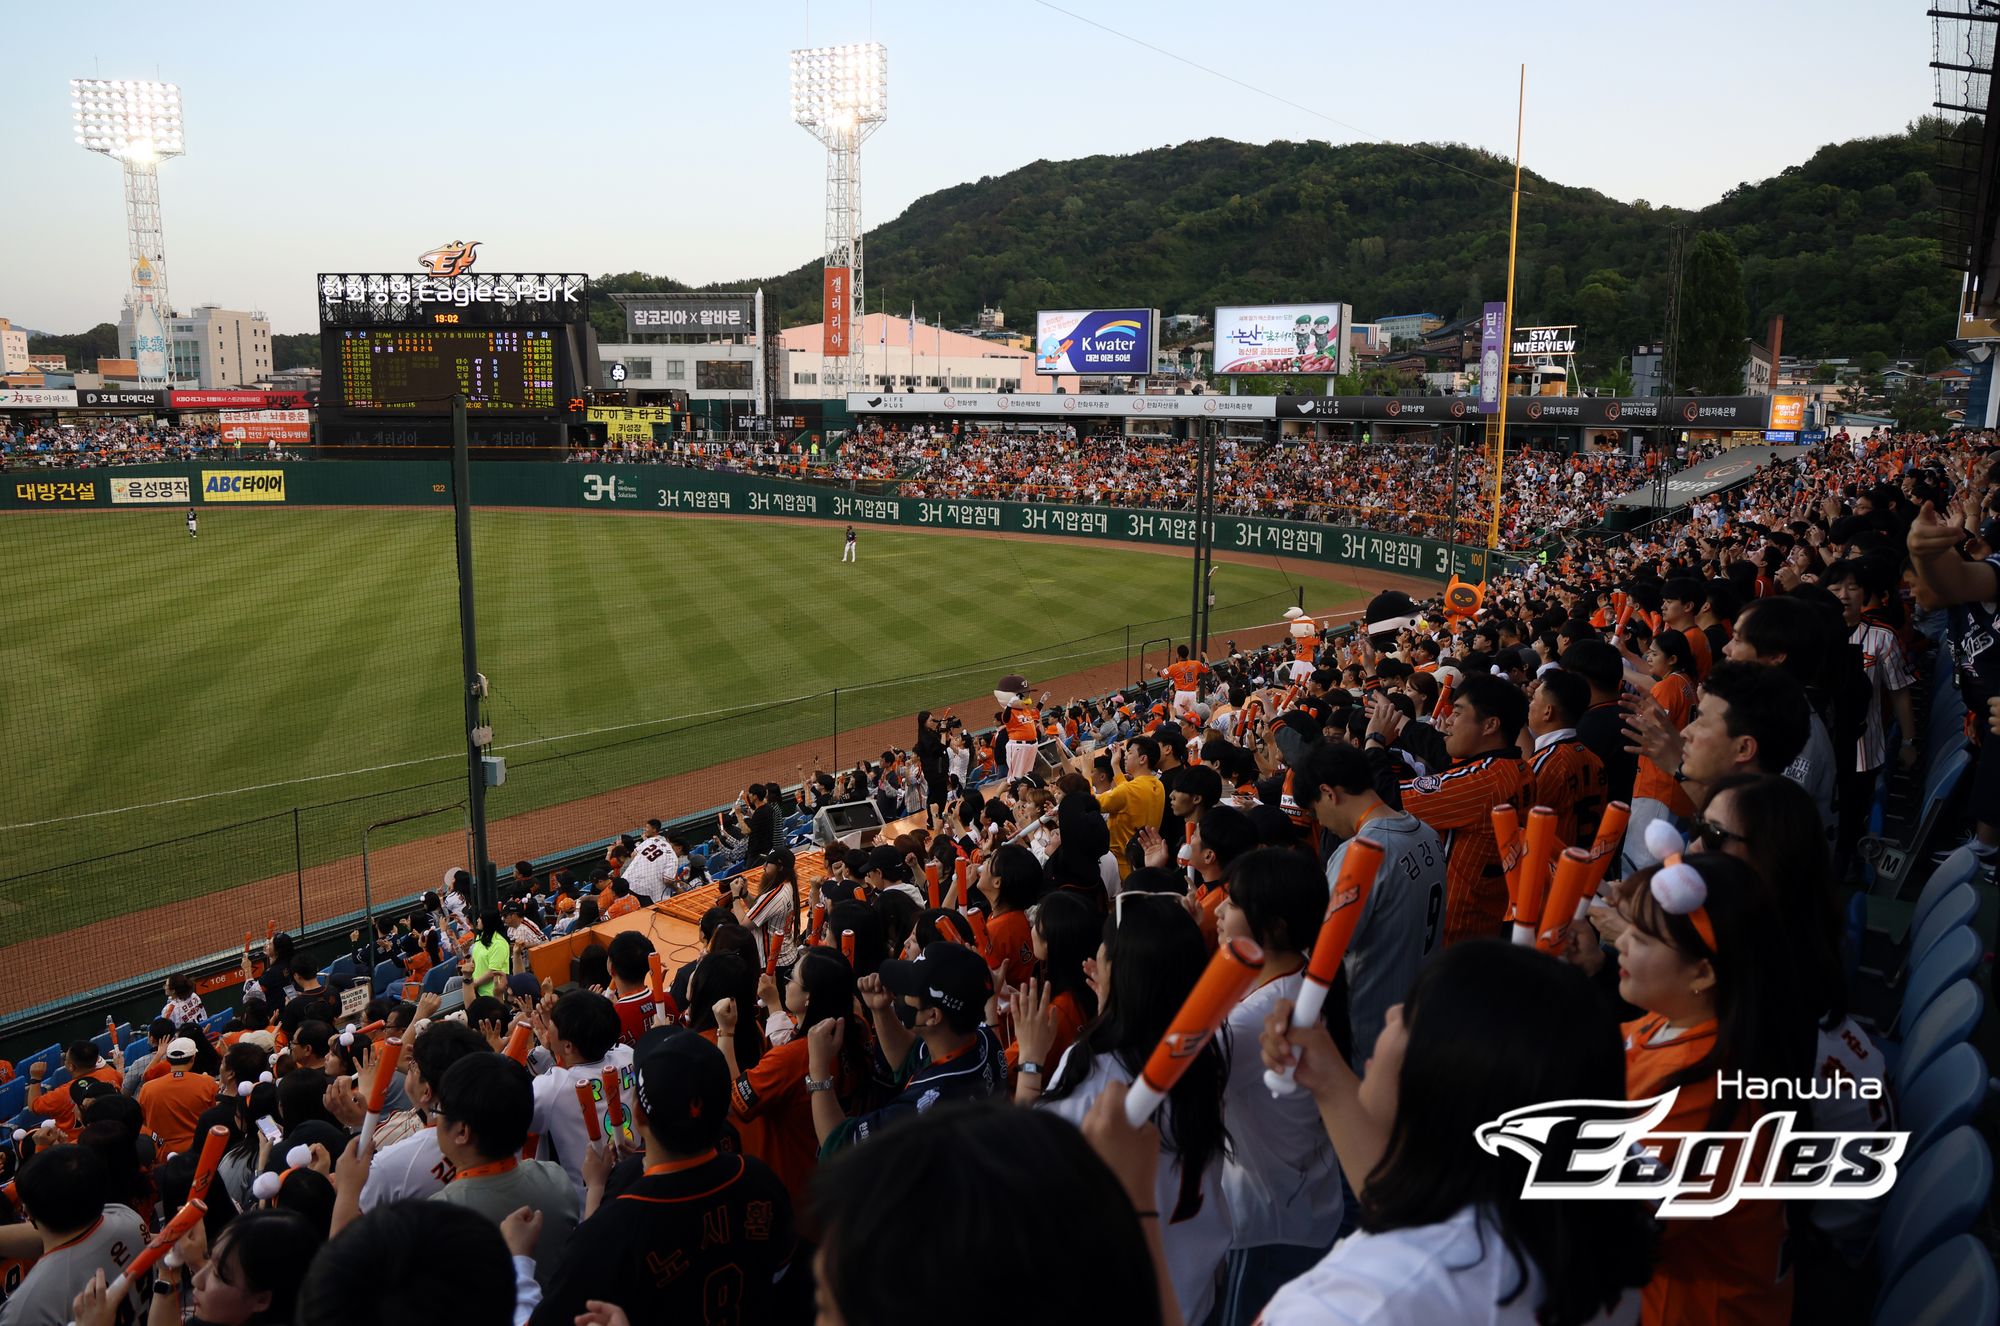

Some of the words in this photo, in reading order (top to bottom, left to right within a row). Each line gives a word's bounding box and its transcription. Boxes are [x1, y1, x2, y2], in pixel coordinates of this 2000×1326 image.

[322, 281, 411, 304] 한화생명
[418, 282, 510, 307] Eagles
[516, 282, 579, 302] Park
[434, 314, 458, 322] 19:02
[634, 310, 687, 325] 잡코리아
[700, 310, 740, 324] 알바몬
[831, 274, 842, 348] 갤러리아
[1484, 312, 1496, 338] 딥스
[1082, 338, 1092, 350] K
[1096, 338, 1135, 350] water
[1531, 330, 1558, 340] STAY
[1513, 341, 1575, 352] INTERVIEW
[1086, 354, 1099, 362] 대전
[1101, 354, 1113, 362] 이전
[1115, 354, 1130, 362] 50년
[101, 394, 118, 403] 호텔
[121, 394, 154, 403] 디에디션
[1542, 407, 1579, 415] 한화투자증권
[1621, 407, 1657, 416] 한화자산운용
[1699, 407, 1736, 417] 한화저축은행
[618, 424, 641, 432] 키성장
[373, 432, 417, 446] 갤러리아
[492, 432, 537, 446] 갤러리아
[16, 482, 96, 501] 대방건설
[128, 481, 188, 498] 음성명작
[206, 475, 282, 493] ABC타이어
[584, 474, 616, 501] 3H
[658, 489, 679, 507] 3H
[684, 491, 730, 509] 지압침대
[748, 492, 770, 510] 3H
[773, 493, 816, 512] 지압침대
[833, 497, 851, 516] 3H
[854, 499, 899, 520] 지압침대
[918, 502, 942, 523] 3H
[947, 504, 1000, 526] 지압침대
[1022, 508, 1047, 529] 3H
[1051, 511, 1108, 534] 지압침대
[1128, 515, 1154, 536] 3H
[1236, 523, 1262, 547] 3H
[1267, 527, 1322, 554] 지압침대
[1341, 534, 1366, 560] 3H
[1371, 539, 1422, 568] 지압침대
[1472, 553, 1482, 566] 100
[641, 844, 663, 862] 29
[1882, 854, 1899, 874] M
[1424, 882, 1442, 956] 9
[211, 975, 226, 984] 106
[234, 970, 244, 978] 10
[646, 1200, 774, 1288] 노시환
